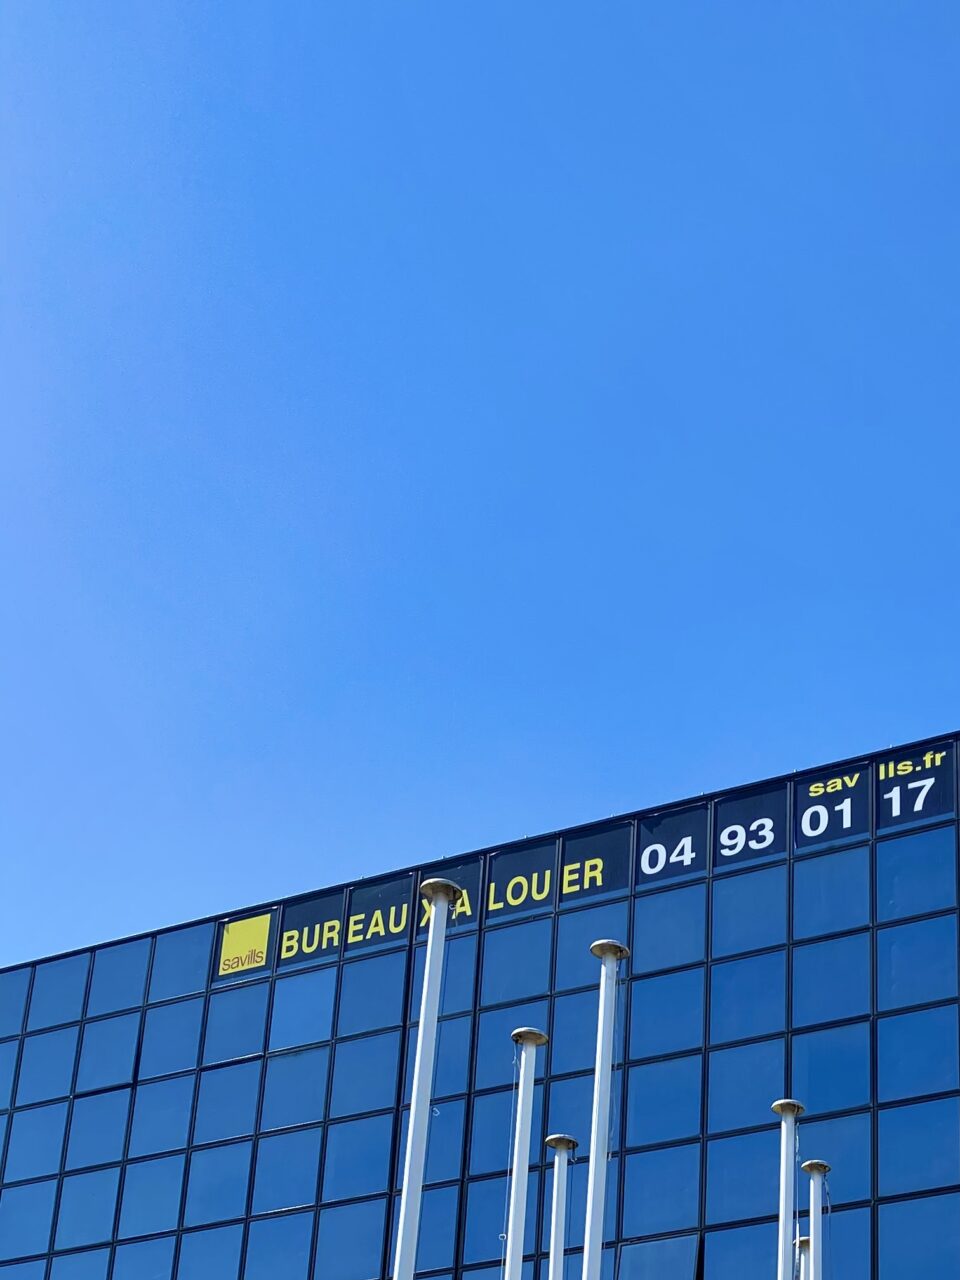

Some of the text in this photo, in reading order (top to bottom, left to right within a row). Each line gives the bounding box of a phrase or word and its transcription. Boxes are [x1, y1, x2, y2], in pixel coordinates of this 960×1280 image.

[640, 836, 696, 875] 04
[719, 818, 775, 857] 93
[801, 798, 852, 837] 01
[884, 777, 936, 817] 17
[488, 858, 604, 911] LOUER
[222, 949, 264, 971] savills
